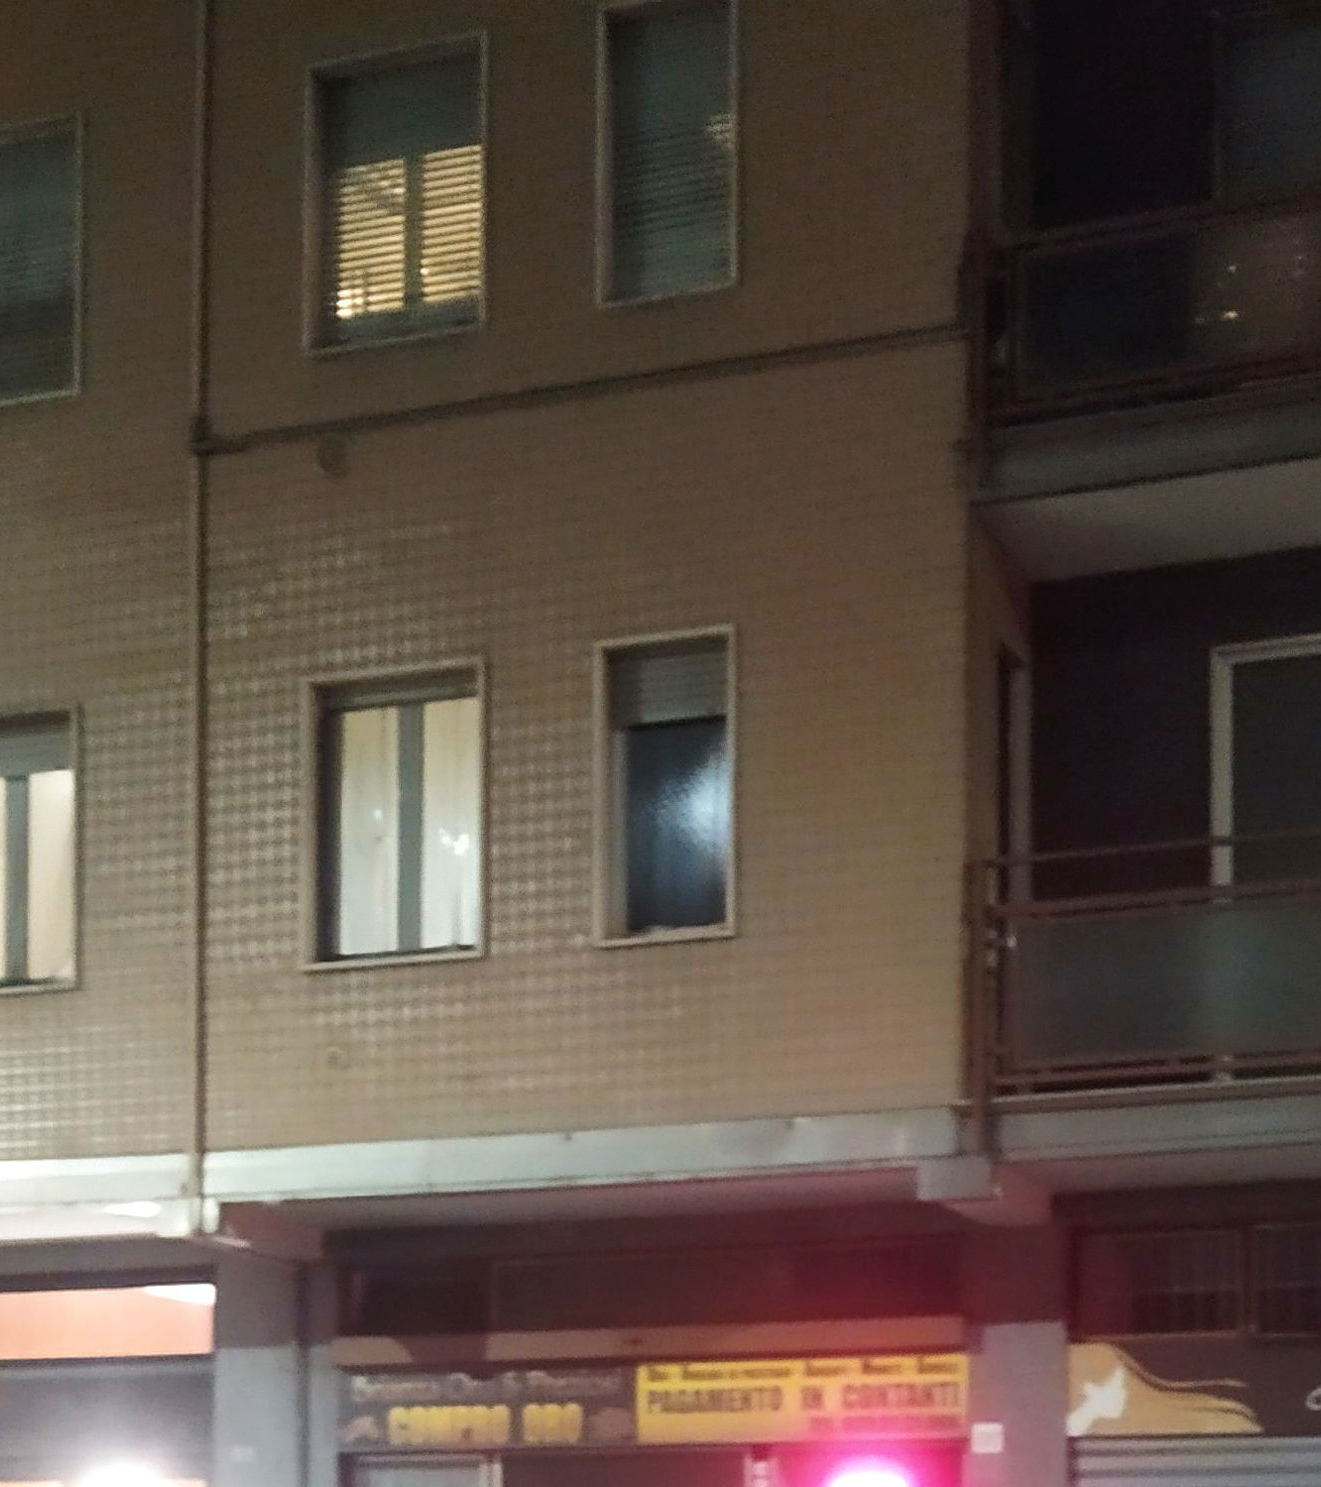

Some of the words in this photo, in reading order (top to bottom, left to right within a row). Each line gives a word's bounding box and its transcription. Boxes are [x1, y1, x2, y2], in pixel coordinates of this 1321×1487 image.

[646, 1386, 783, 1414] PAGAMENTO
[801, 1385, 825, 1412] IN
[839, 1379, 962, 1410] CONTANTI
[386, 1403, 511, 1445] COMPRO
